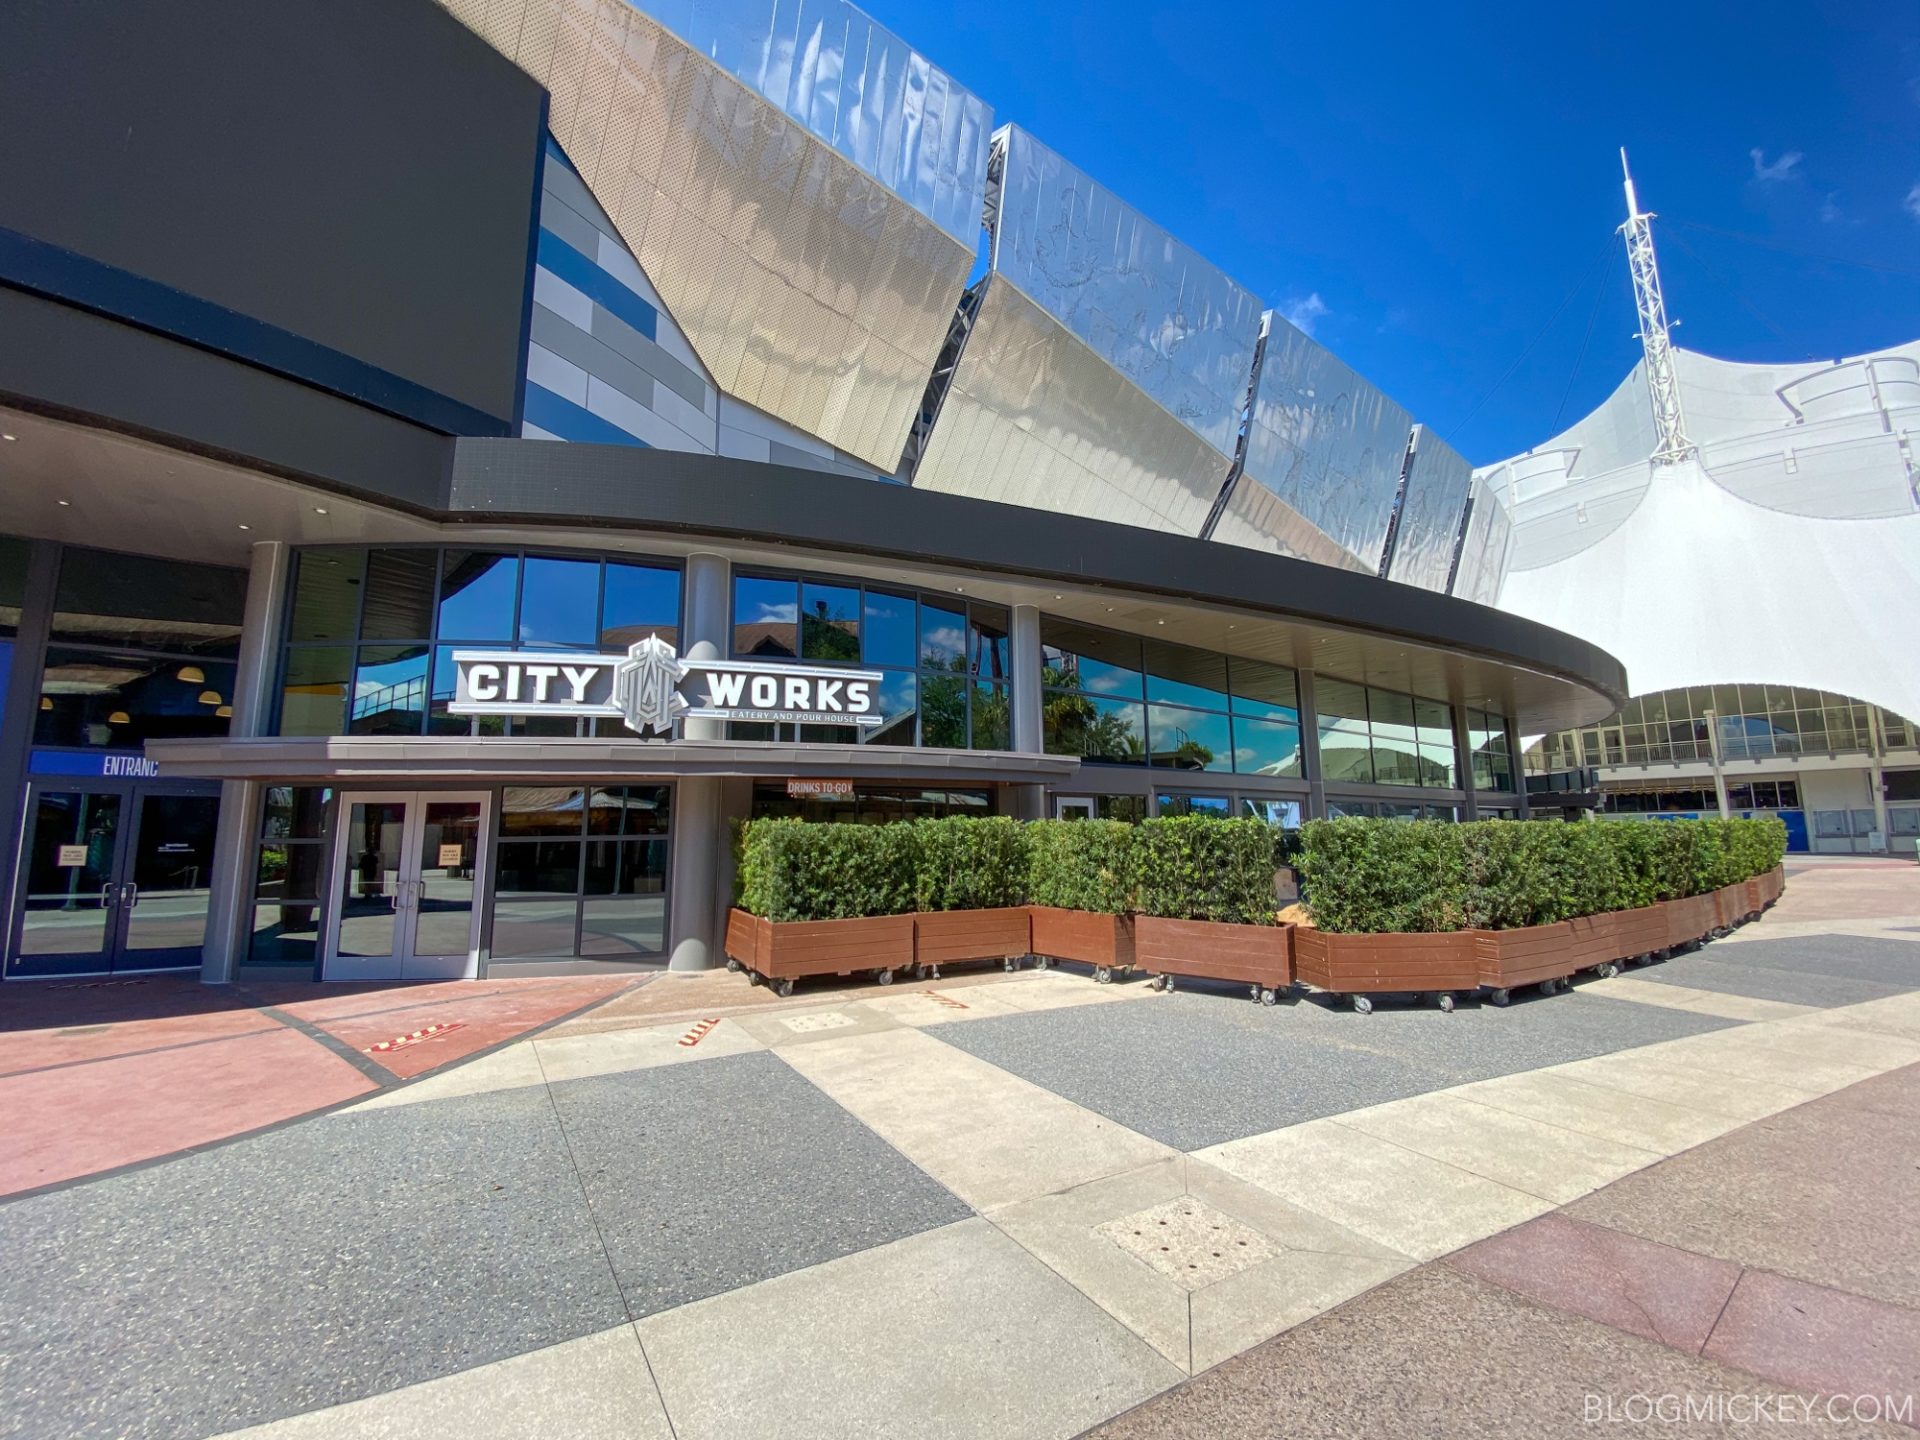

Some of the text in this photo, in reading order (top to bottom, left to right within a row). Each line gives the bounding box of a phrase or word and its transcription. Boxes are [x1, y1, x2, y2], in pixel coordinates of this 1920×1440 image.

[468, 664, 871, 713] CITY WORKS
[731, 710, 854, 723] EATERY AND POUR HOUSE
[788, 782, 847, 793] DRINKS TO-GO
